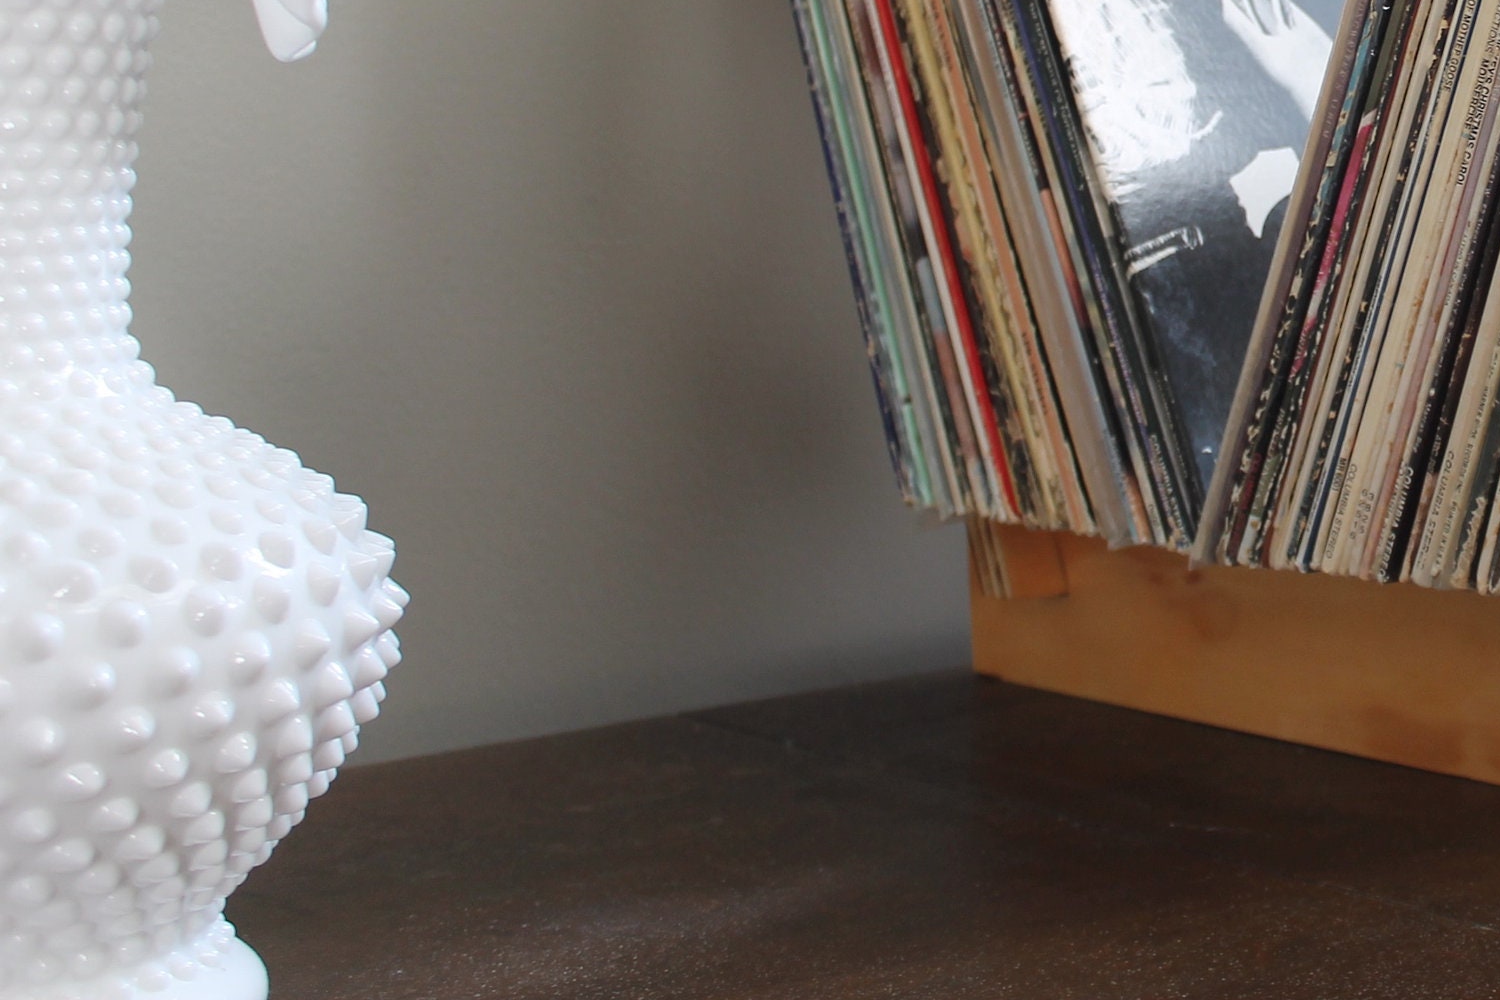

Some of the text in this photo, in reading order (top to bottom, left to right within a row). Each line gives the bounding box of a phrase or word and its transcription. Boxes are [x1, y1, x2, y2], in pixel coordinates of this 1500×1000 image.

[1466, 0, 1476, 11] OF
[1453, 14, 1471, 54] MOTHER
[1442, 58, 1459, 92] GOOSE
[1463, 58, 1489, 129] MOUSERCISE
[1465, 86, 1489, 148] CHRISTMAS
[1455, 150, 1471, 186] CAROL
[1336, 457, 1346, 472] MR
[1430, 450, 1454, 516] COLUMBIA
[1325, 463, 1357, 560] COLUMBIA STEREO
[1390, 466, 1413, 528] COLUMBIA
[1377, 532, 1395, 578] STEREO
